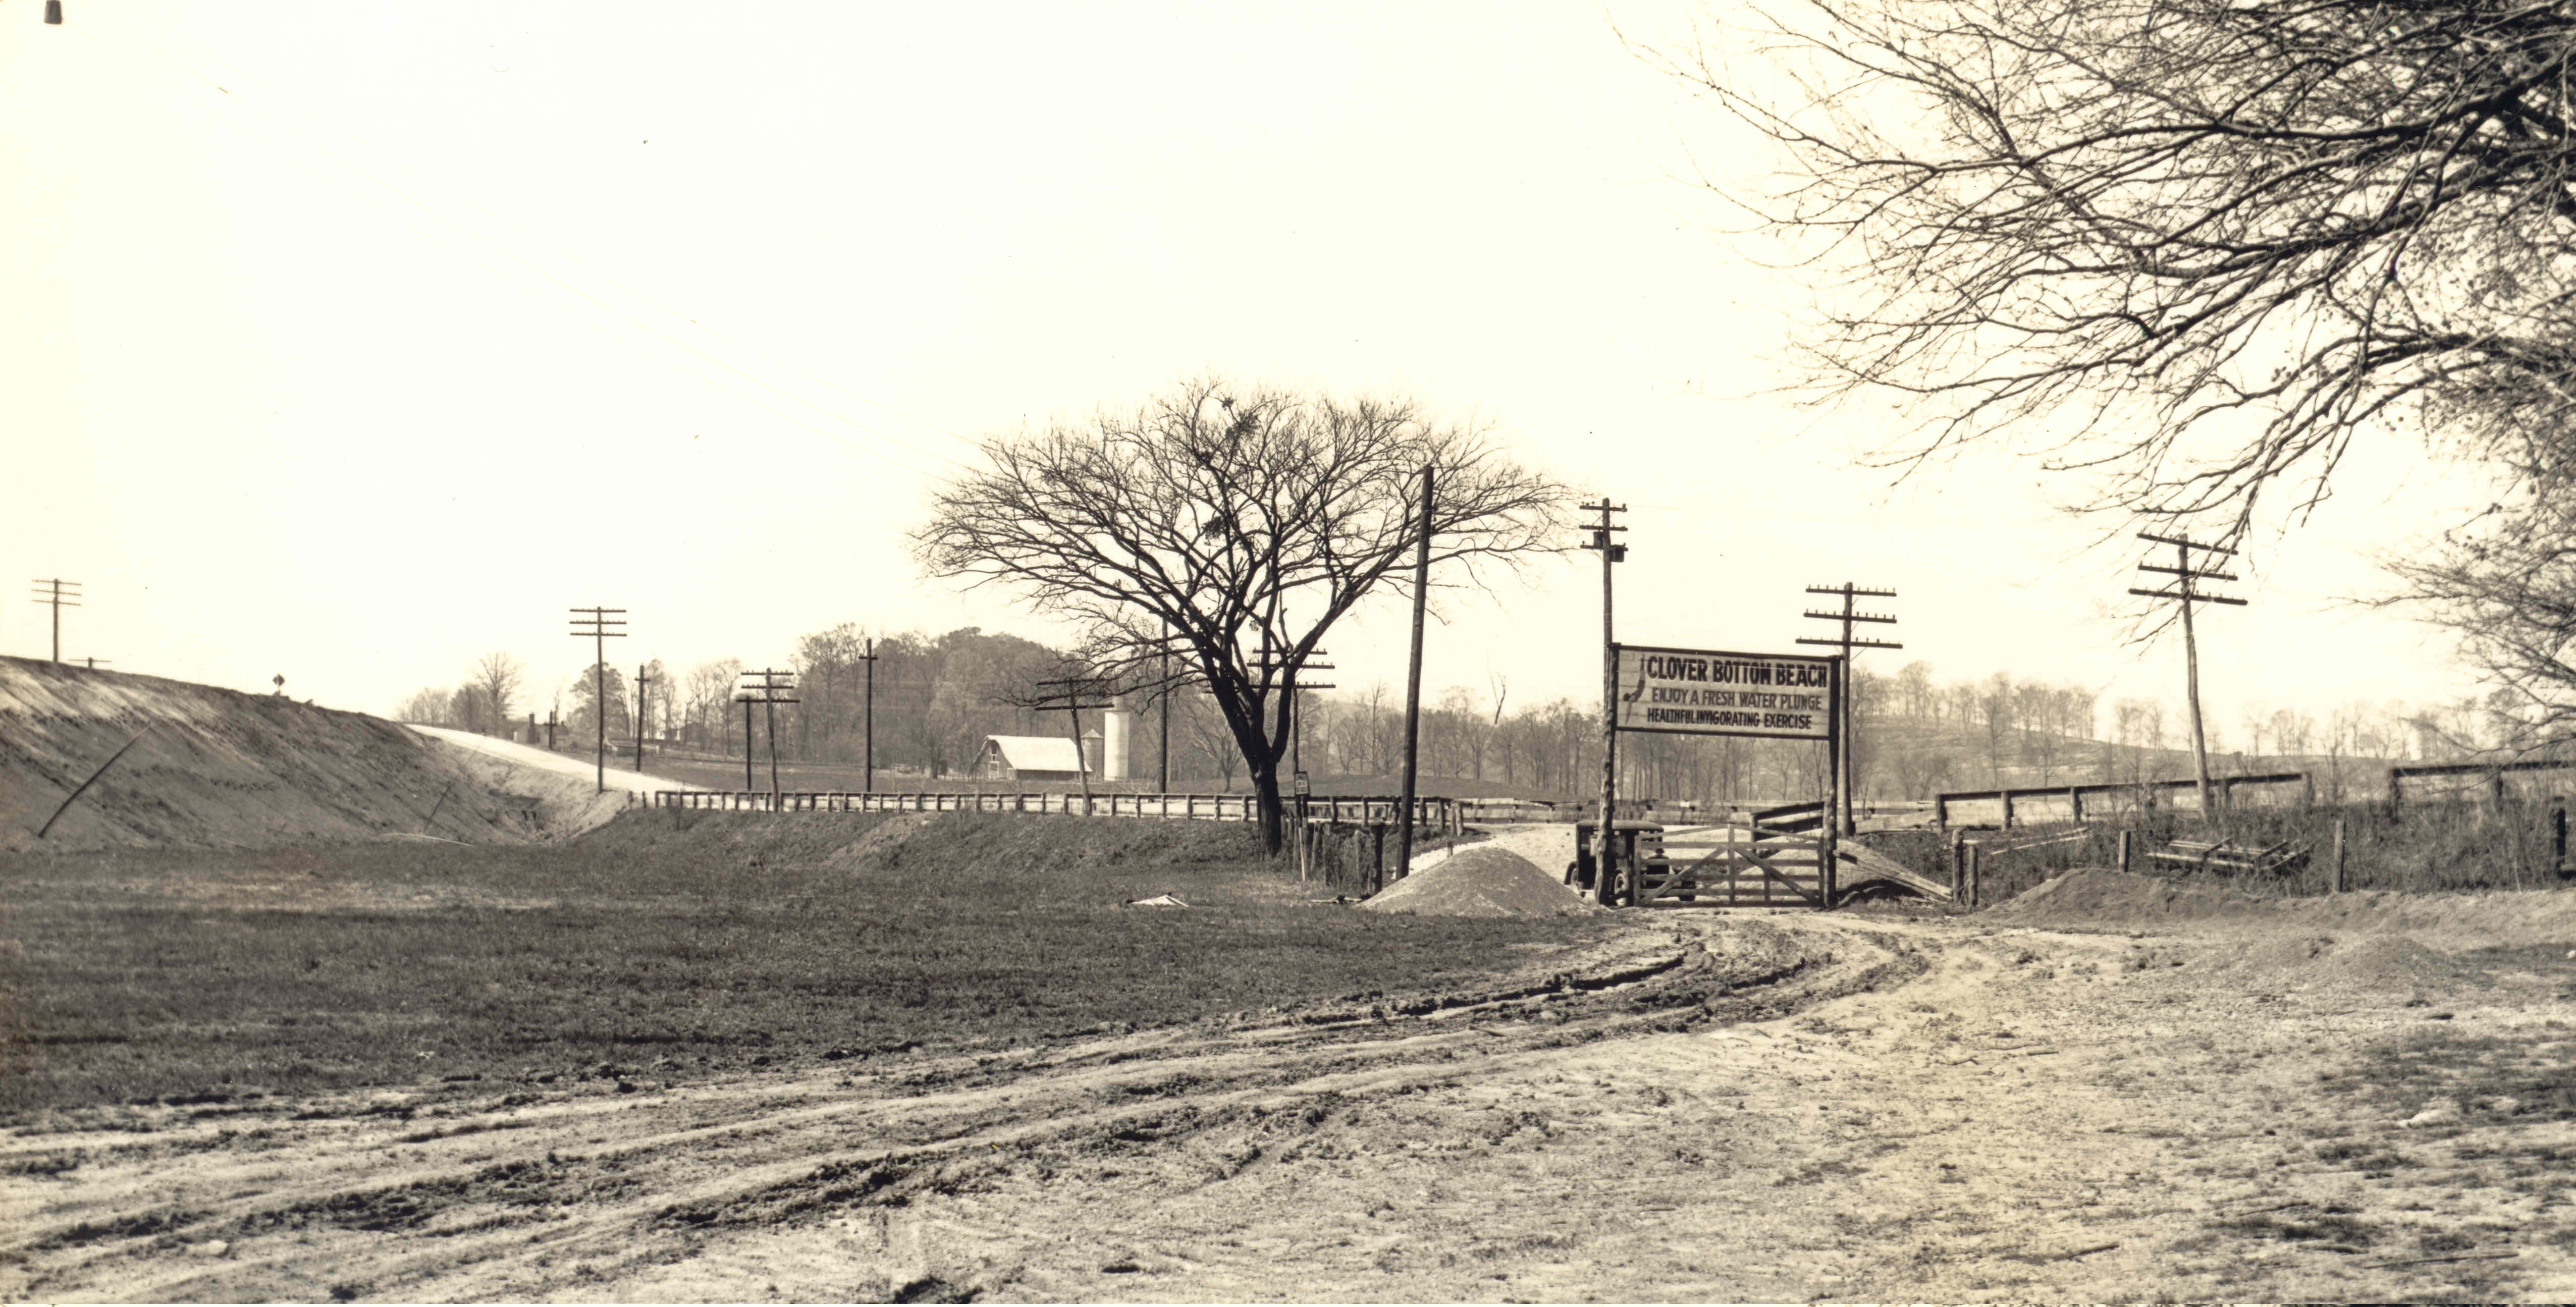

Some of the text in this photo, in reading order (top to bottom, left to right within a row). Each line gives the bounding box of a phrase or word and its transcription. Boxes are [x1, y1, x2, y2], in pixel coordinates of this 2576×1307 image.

[1647, 656, 1827, 687] CLOVER BOTTOM BEACH
[1652, 687, 1822, 711] ENJOY A FRESH WATER PLUNGE
[1647, 707, 1812, 729] HEALTHFUL INVIGORATING EXERCISE
